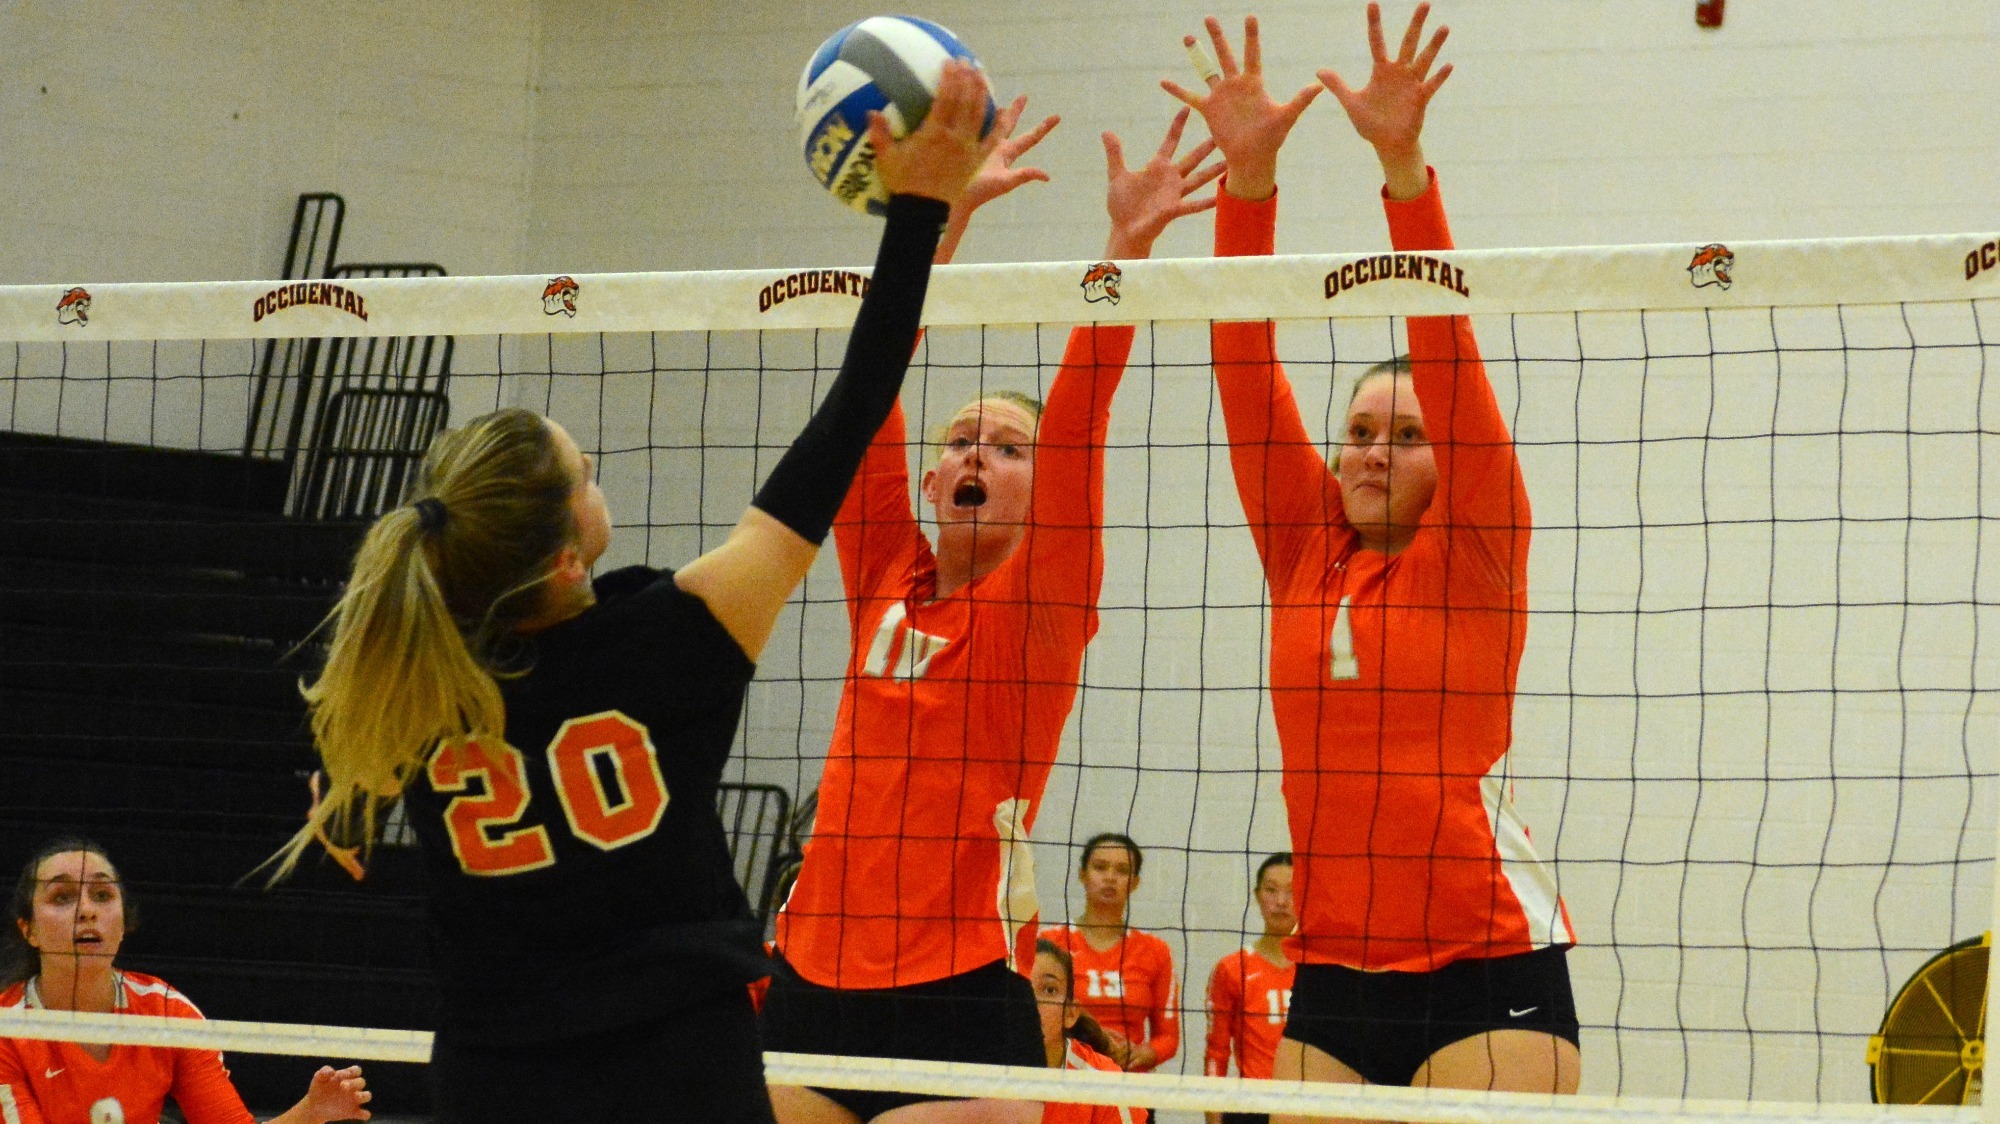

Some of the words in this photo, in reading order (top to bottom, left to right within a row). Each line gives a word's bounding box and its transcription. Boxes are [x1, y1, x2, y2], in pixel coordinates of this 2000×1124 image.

[1324, 254, 1469, 299] OCCIDENTAL
[253, 283, 368, 322] OCCIDENTAL
[1330, 594, 1358, 680] 1
[427, 710, 670, 876] 20
[1086, 969, 1125, 998] 13
